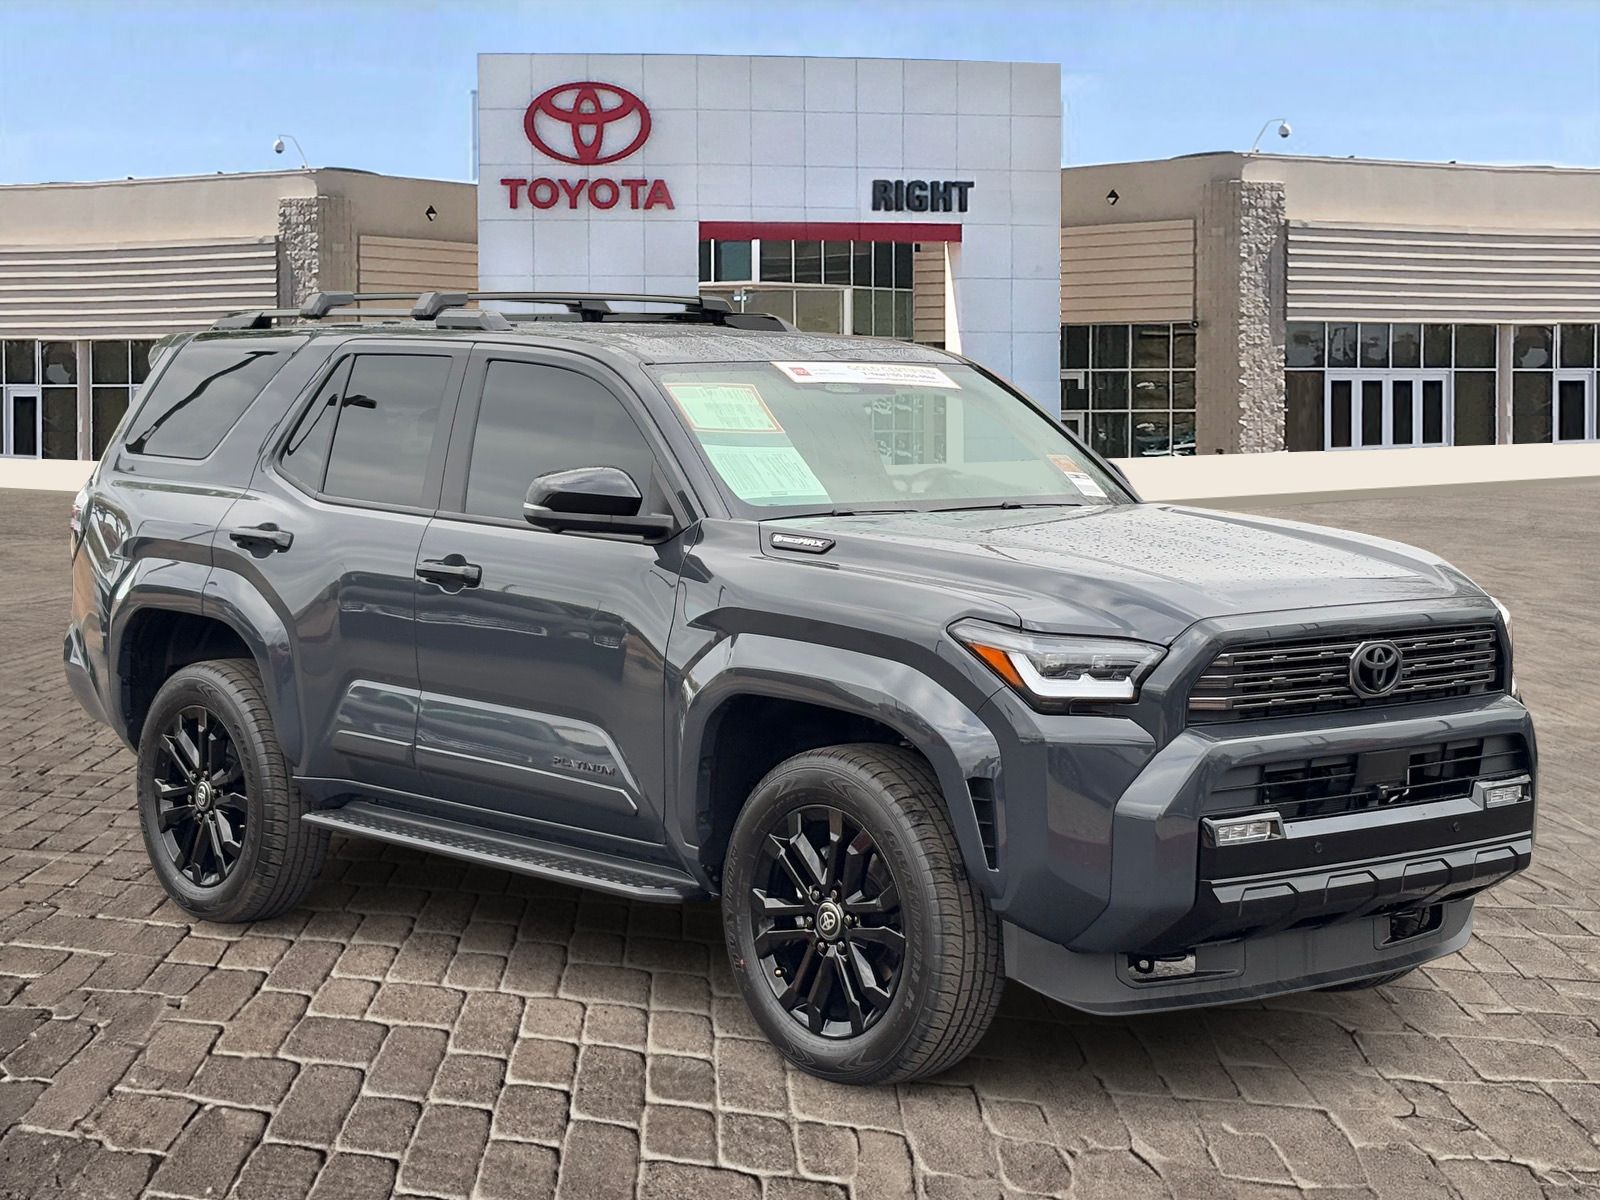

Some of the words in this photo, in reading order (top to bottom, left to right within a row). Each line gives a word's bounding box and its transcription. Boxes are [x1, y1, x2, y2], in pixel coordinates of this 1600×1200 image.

[500, 178, 675, 209] TOYOTA
[872, 179, 975, 212] RIGHT
[552, 755, 617, 776] PLATINUM
